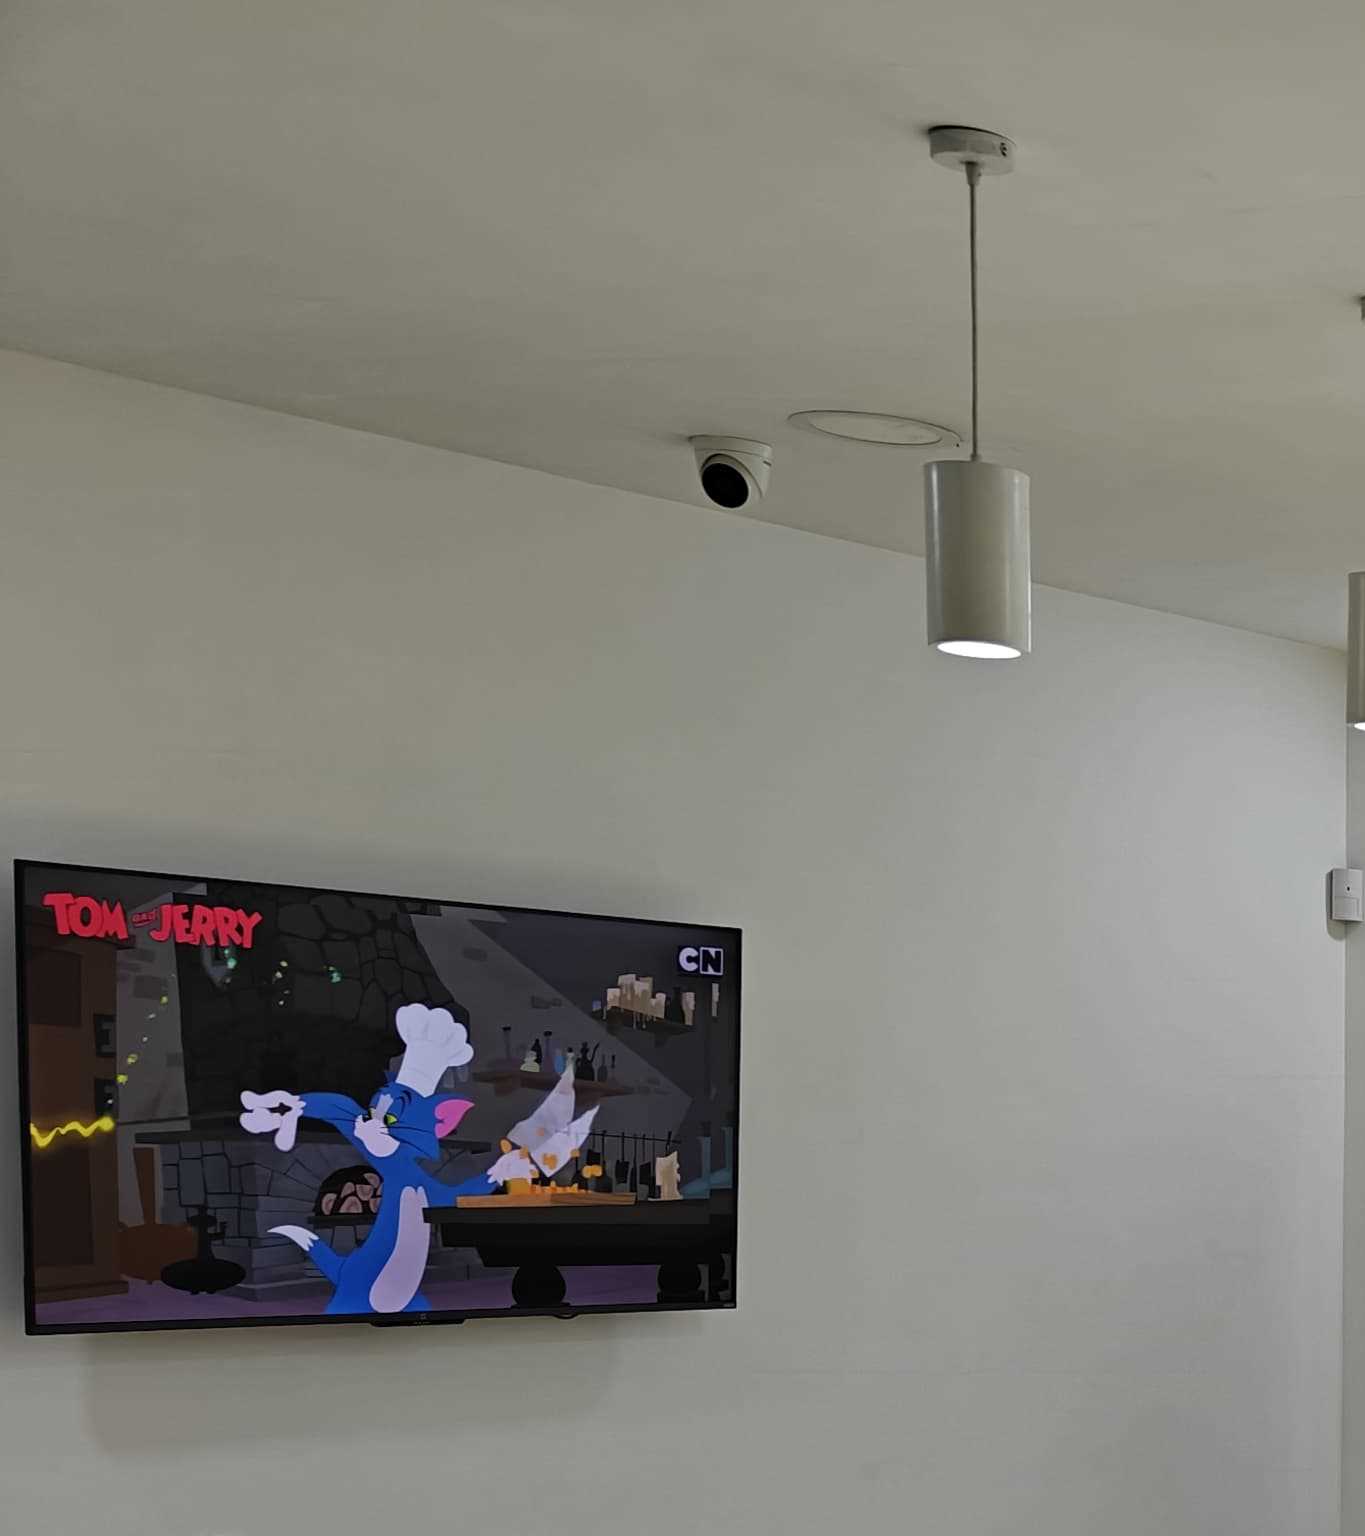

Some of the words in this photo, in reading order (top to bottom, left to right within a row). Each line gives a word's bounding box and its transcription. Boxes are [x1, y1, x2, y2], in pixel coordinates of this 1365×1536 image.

[42, 892, 129, 941] TOM
[150, 904, 263, 949] JERRY
[678, 946, 724, 976] CN
